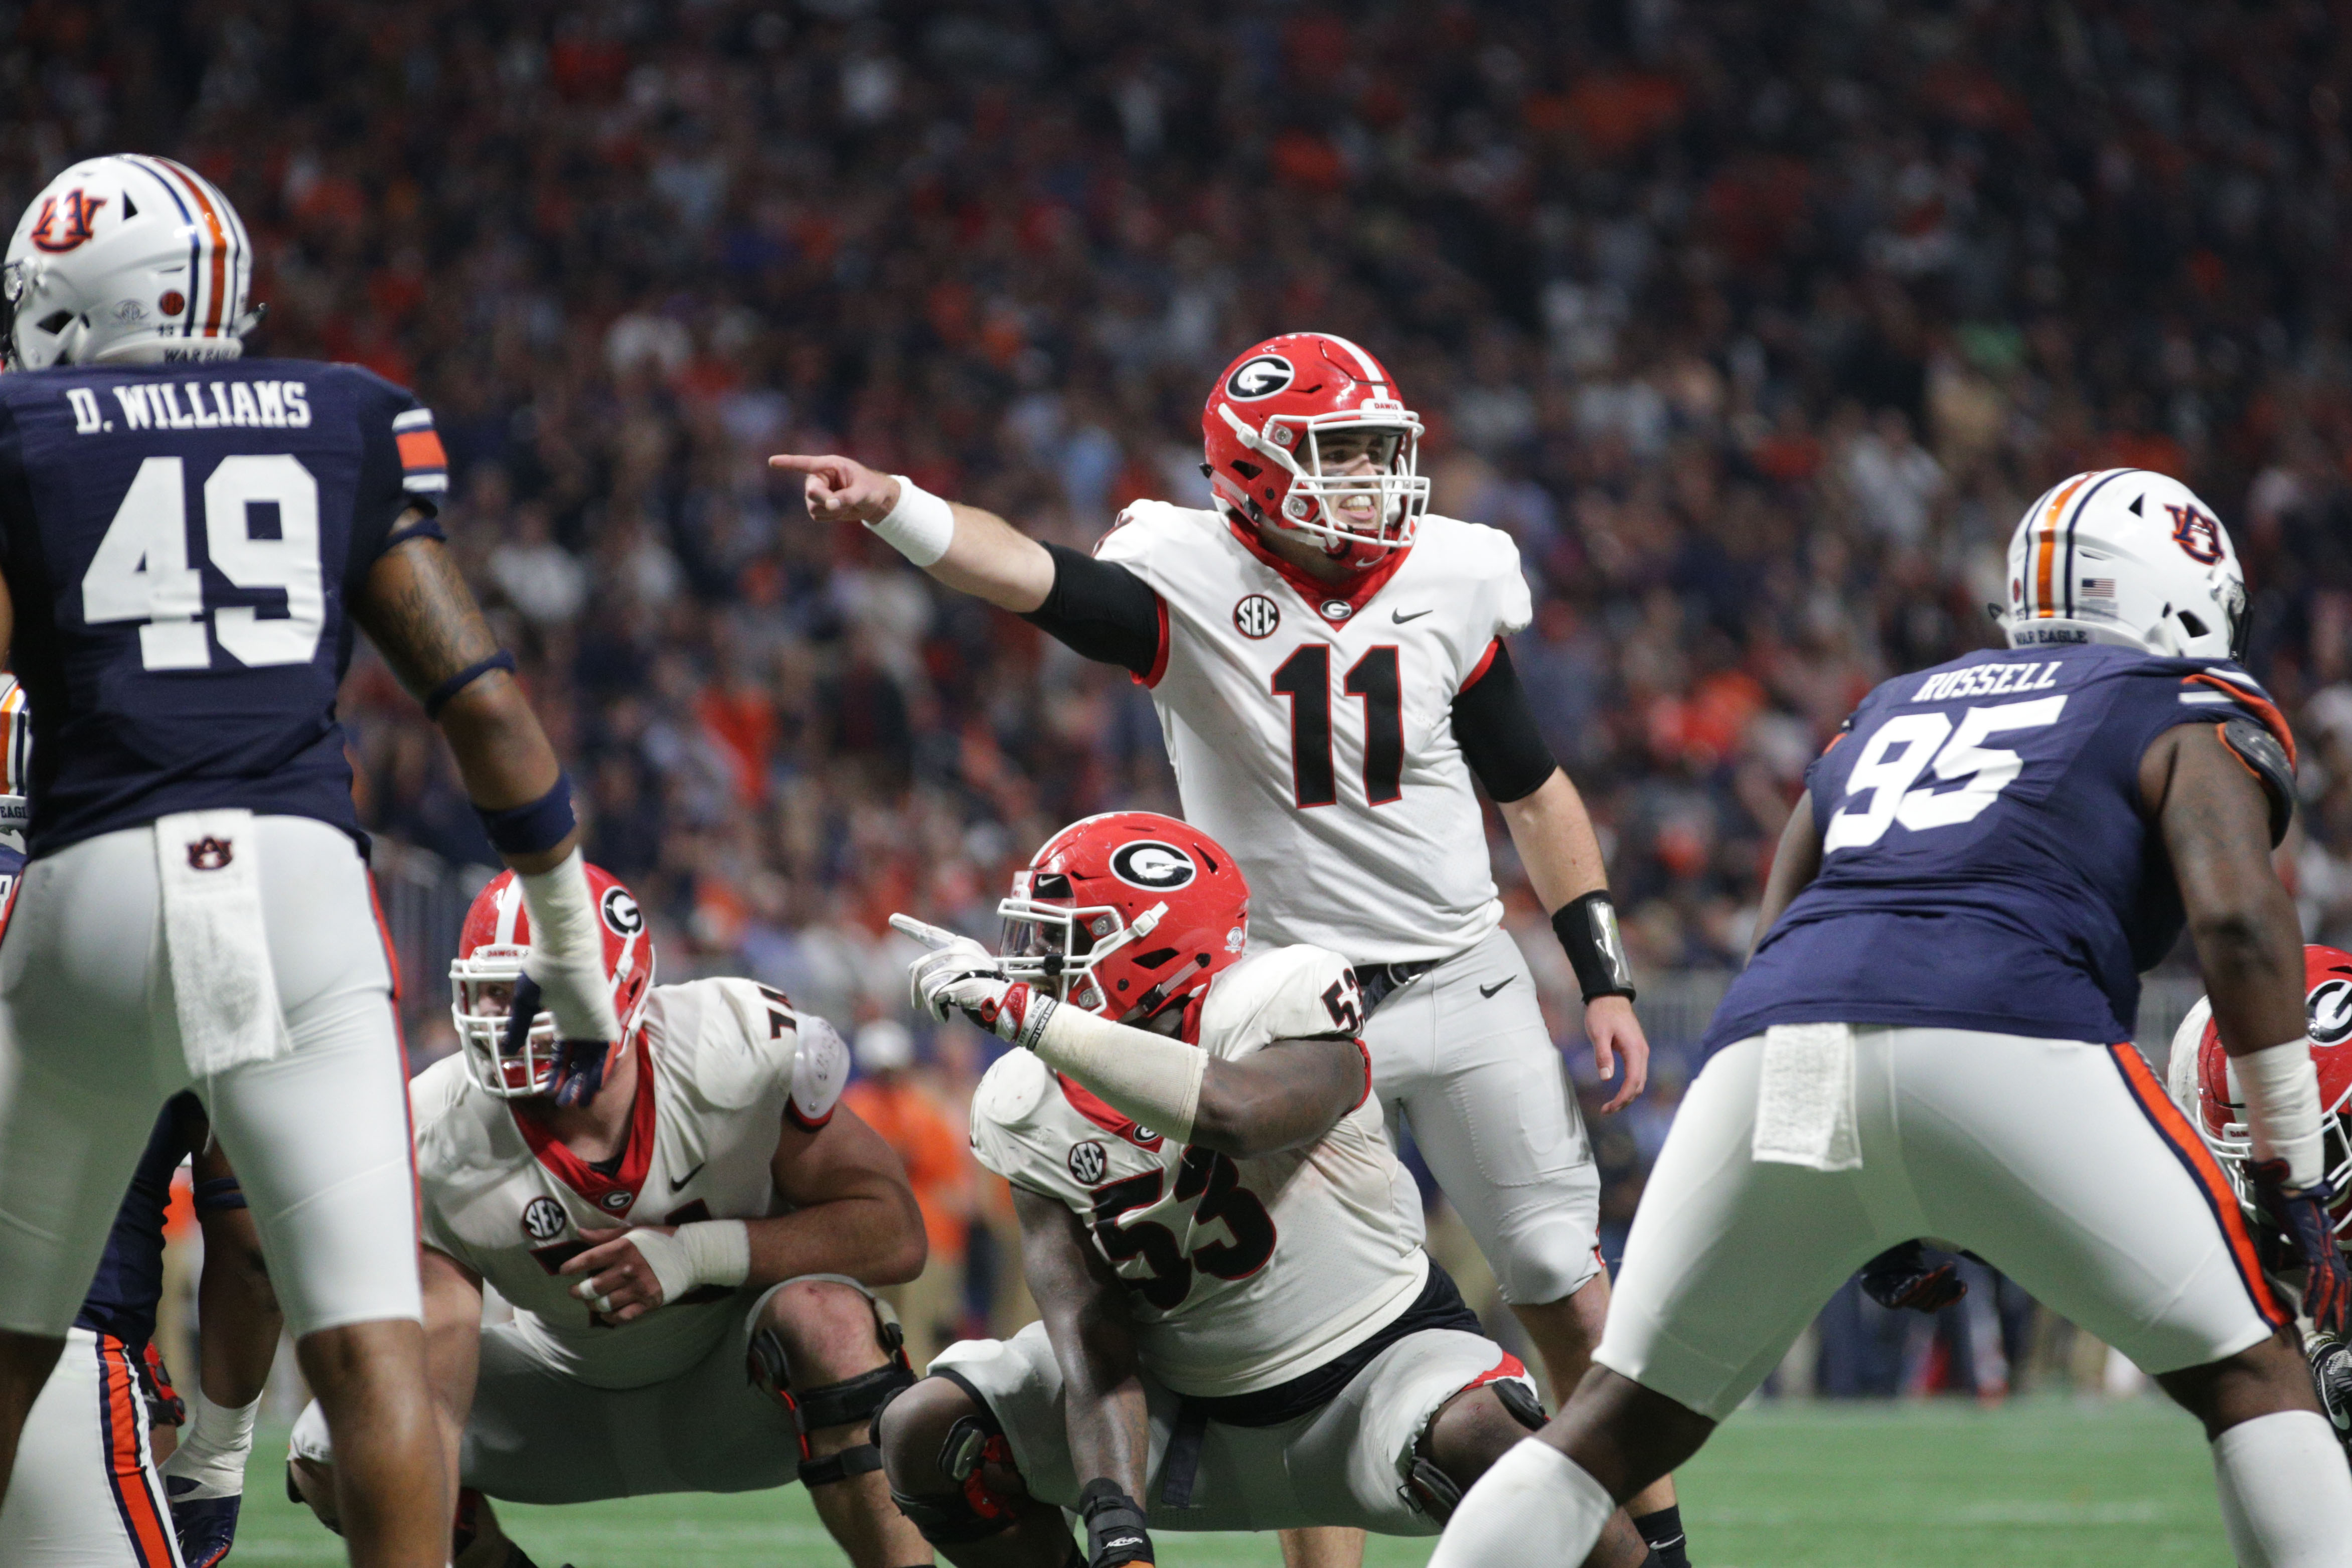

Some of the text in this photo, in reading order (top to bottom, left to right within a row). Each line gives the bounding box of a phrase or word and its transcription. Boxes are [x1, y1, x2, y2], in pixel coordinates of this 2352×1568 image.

[66, 380, 312, 434] D. WILLIAMS
[82, 452, 326, 671] 49
[1237, 596, 1276, 637] SEC
[2014, 630, 2089, 646] WAR EAGLE
[1910, 661, 2064, 702] RUSSELL
[1271, 643, 1404, 810] 11
[1824, 695, 2068, 855] 95
[0, 806, 27, 819] EAGL
[487, 949, 518, 958] DAWGS
[1070, 1141, 1104, 1182] SEC
[525, 1199, 566, 1239] SEC
[1089, 1144, 1277, 1311] 53
